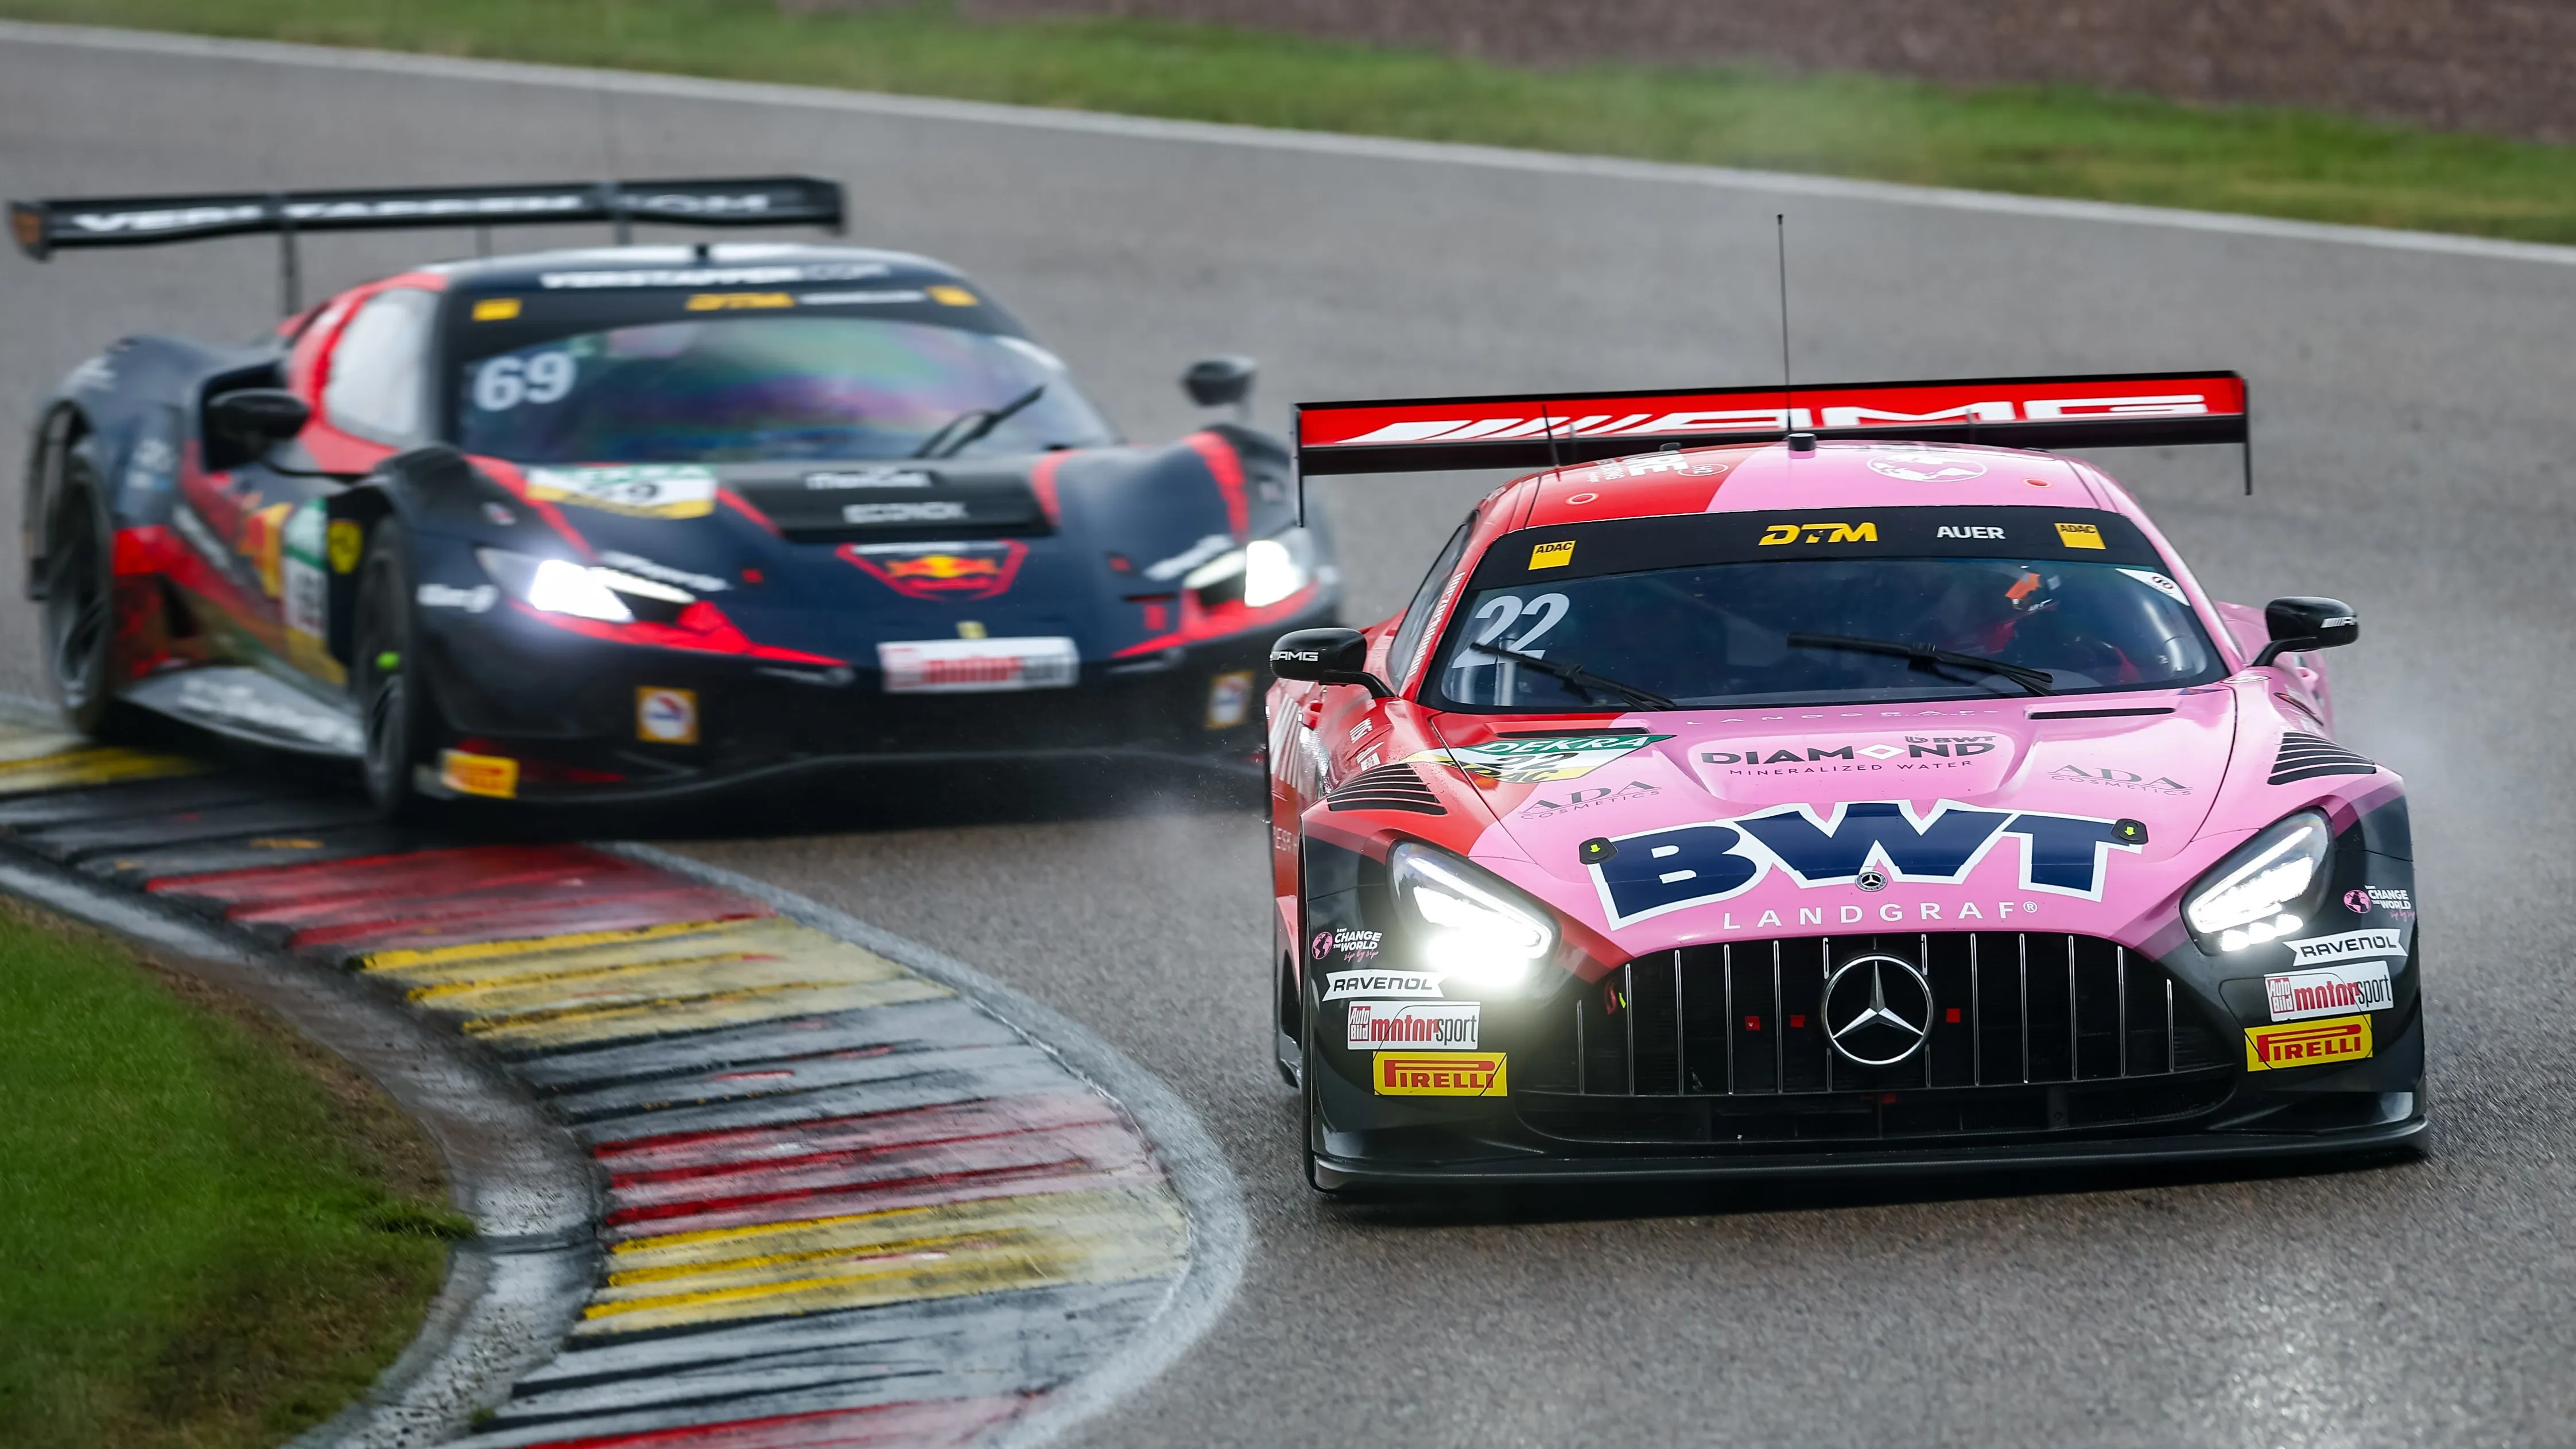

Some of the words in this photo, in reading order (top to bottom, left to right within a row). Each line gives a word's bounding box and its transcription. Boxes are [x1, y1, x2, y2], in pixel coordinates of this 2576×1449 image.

[473, 351, 577, 412] 69
[1616, 394, 2208, 432] AMG
[1759, 522, 1879, 545] DTM
[1937, 526, 2006, 540] AUER
[2059, 524, 2097, 534] ADAC
[1535, 542, 1573, 554] ADAC
[1451, 592, 1570, 669] 22
[1278, 651, 1319, 661] AMG
[1476, 736, 1649, 754] DEKRA
[1729, 764, 1883, 776] MINERALIZED
[1896, 761, 1972, 770] WATER
[2047, 764, 2194, 790] ADA
[2051, 775, 2192, 796] COSMETICS
[1517, 781, 1662, 815] ADA
[1520, 791, 1661, 820] COSMETICS
[1599, 801, 2133, 922] BWT
[2368, 889, 2410, 900] CHANGE
[2380, 900, 2411, 909] WORLD
[1334, 930, 1383, 943] CHANGE
[1340, 940, 1378, 952] WORLD
[2299, 936, 2397, 958] RAVENOL
[1344, 952, 1355, 963] sip
[1365, 950, 1379, 960] sip
[1333, 977, 1433, 992] RAVENOL
[2269, 979, 2291, 996] Auto
[2293, 974, 2392, 1012] motorsport
[2271, 995, 2294, 1013] Bild
[1349, 1008, 1370, 1025] Auto
[1350, 1025, 1370, 1041] Bild
[1371, 1014, 1477, 1046] motorsport
[2256, 1024, 2362, 1063] PIRELLI
[1384, 1060, 1496, 1088] PIRELLI
